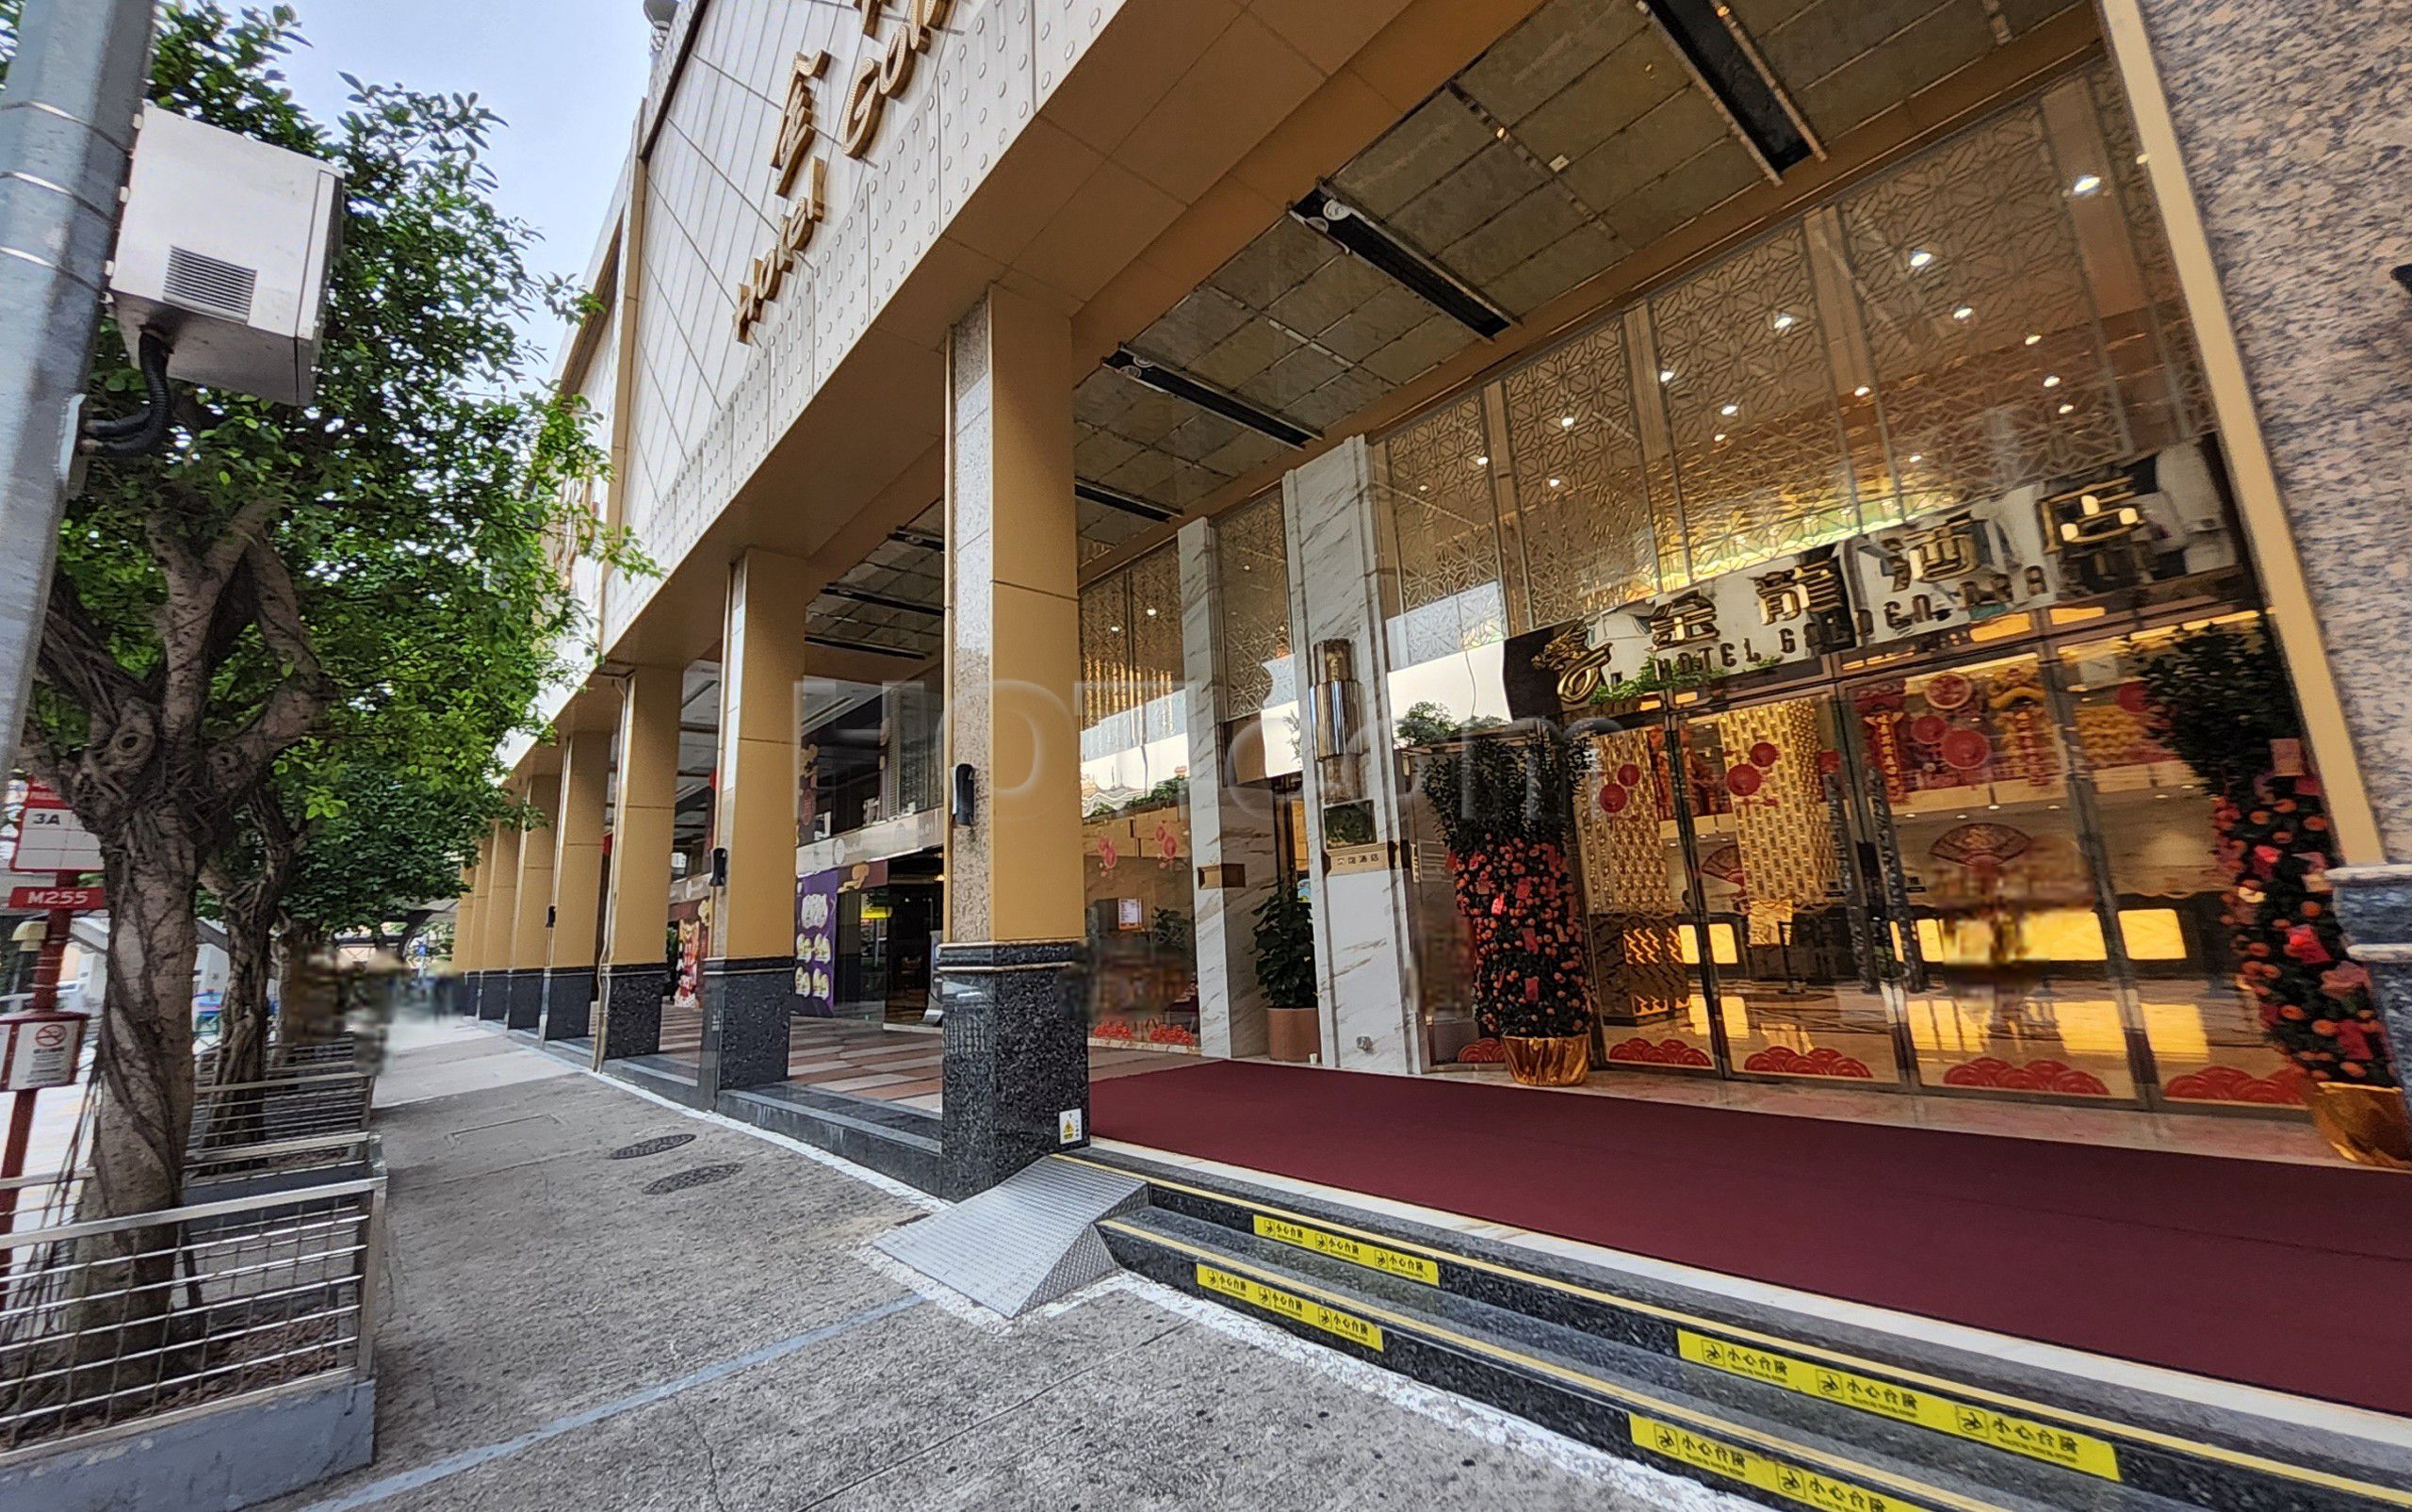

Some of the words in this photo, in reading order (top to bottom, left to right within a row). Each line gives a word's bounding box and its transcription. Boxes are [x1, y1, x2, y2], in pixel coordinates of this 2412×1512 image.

[734, 155, 825, 346] Hotel
[1650, 475, 2147, 652] 金龍酒店
[1654, 638, 1762, 681] HOTEL
[33, 813, 60, 825] 3A
[27, 891, 89, 904] M255
